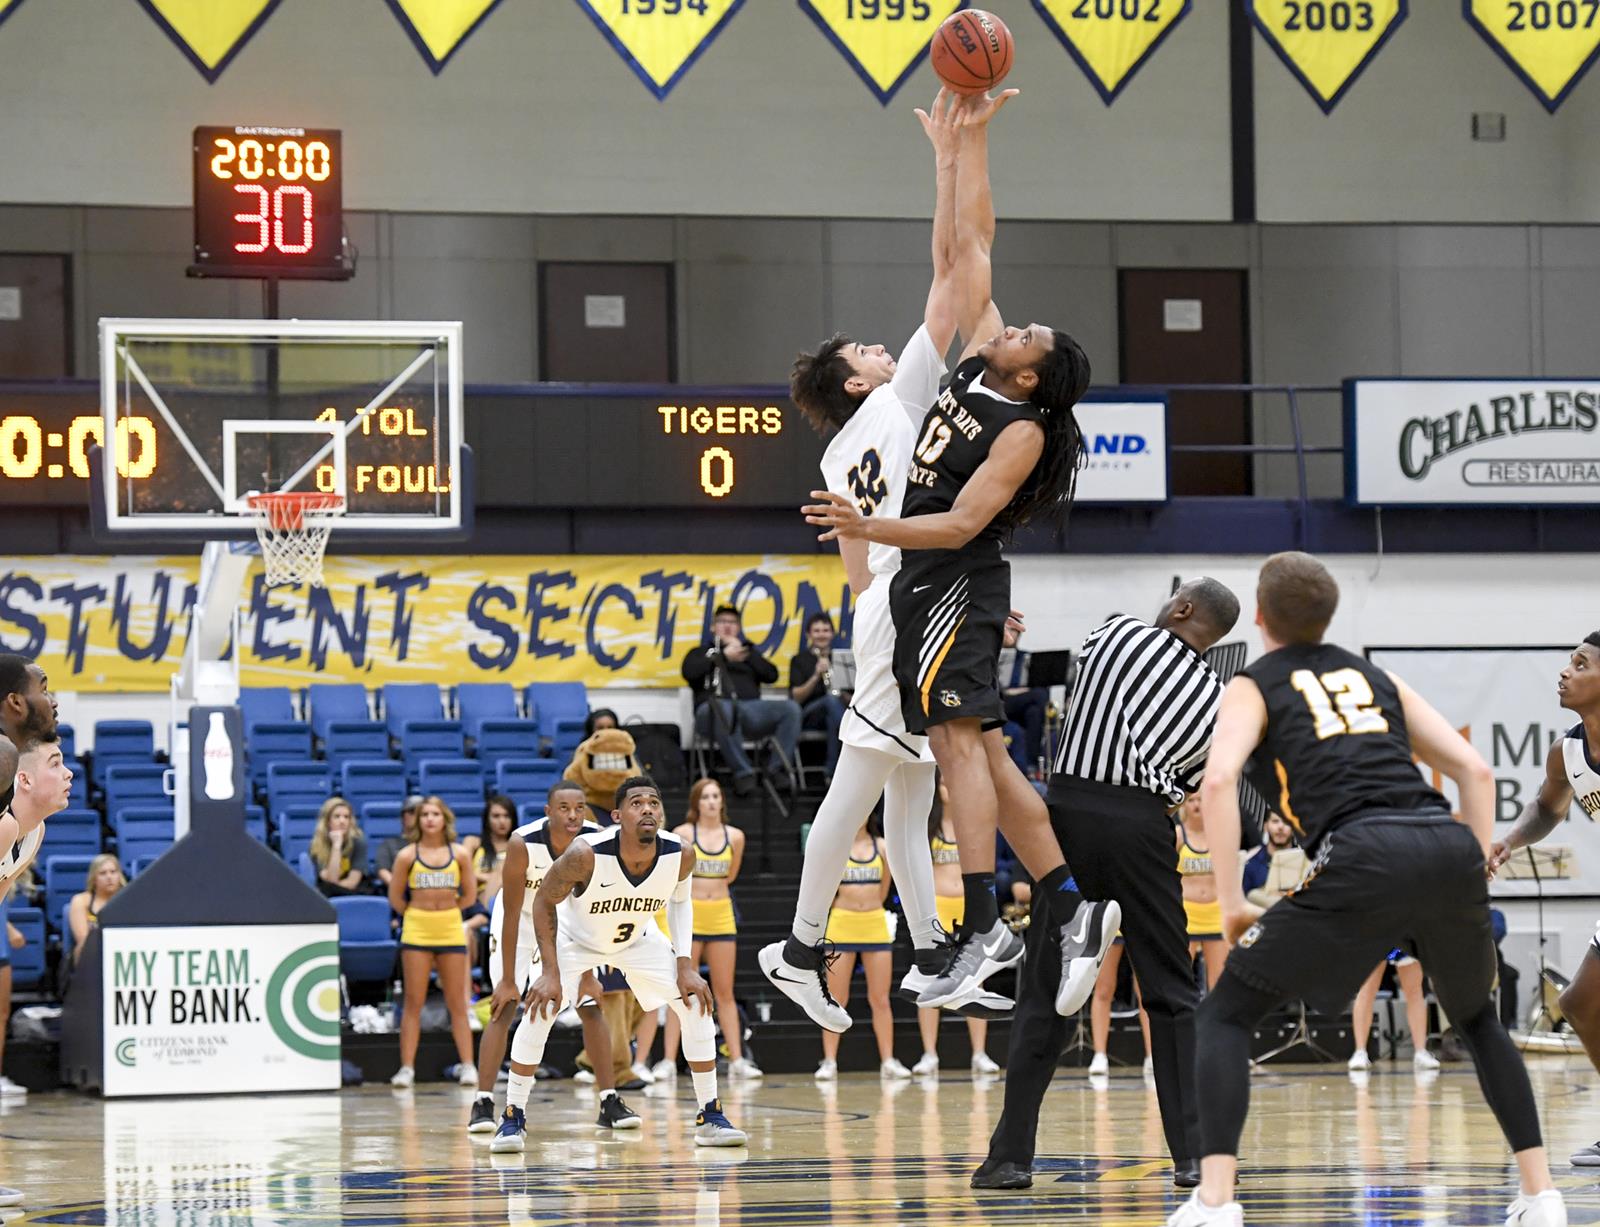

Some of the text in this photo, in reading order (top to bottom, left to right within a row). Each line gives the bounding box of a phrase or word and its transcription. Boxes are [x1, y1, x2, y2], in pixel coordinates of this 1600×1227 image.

[847, 0, 930, 21] 1995
[1072, 0, 1160, 21] 2002
[1284, 1, 1374, 31] 2003
[1506, 0, 1600, 31] 2007
[211, 138, 330, 181] 20:00
[234, 184, 313, 254] 30
[356, 408, 427, 435] TOL
[658, 406, 782, 434] TIGERS
[952, 406, 983, 441] HAYS
[915, 415, 952, 464] 13
[316, 465, 452, 493] 0 FOUL
[701, 447, 734, 497] 0
[1489, 463, 1600, 481] RESTAURA
[0, 569, 854, 675] STUENT SECTION
[1290, 667, 1389, 740] 12
[613, 923, 635, 943] 3
[114, 949, 260, 987] MY TEAM.
[114, 987, 261, 1026] MY BANK.
